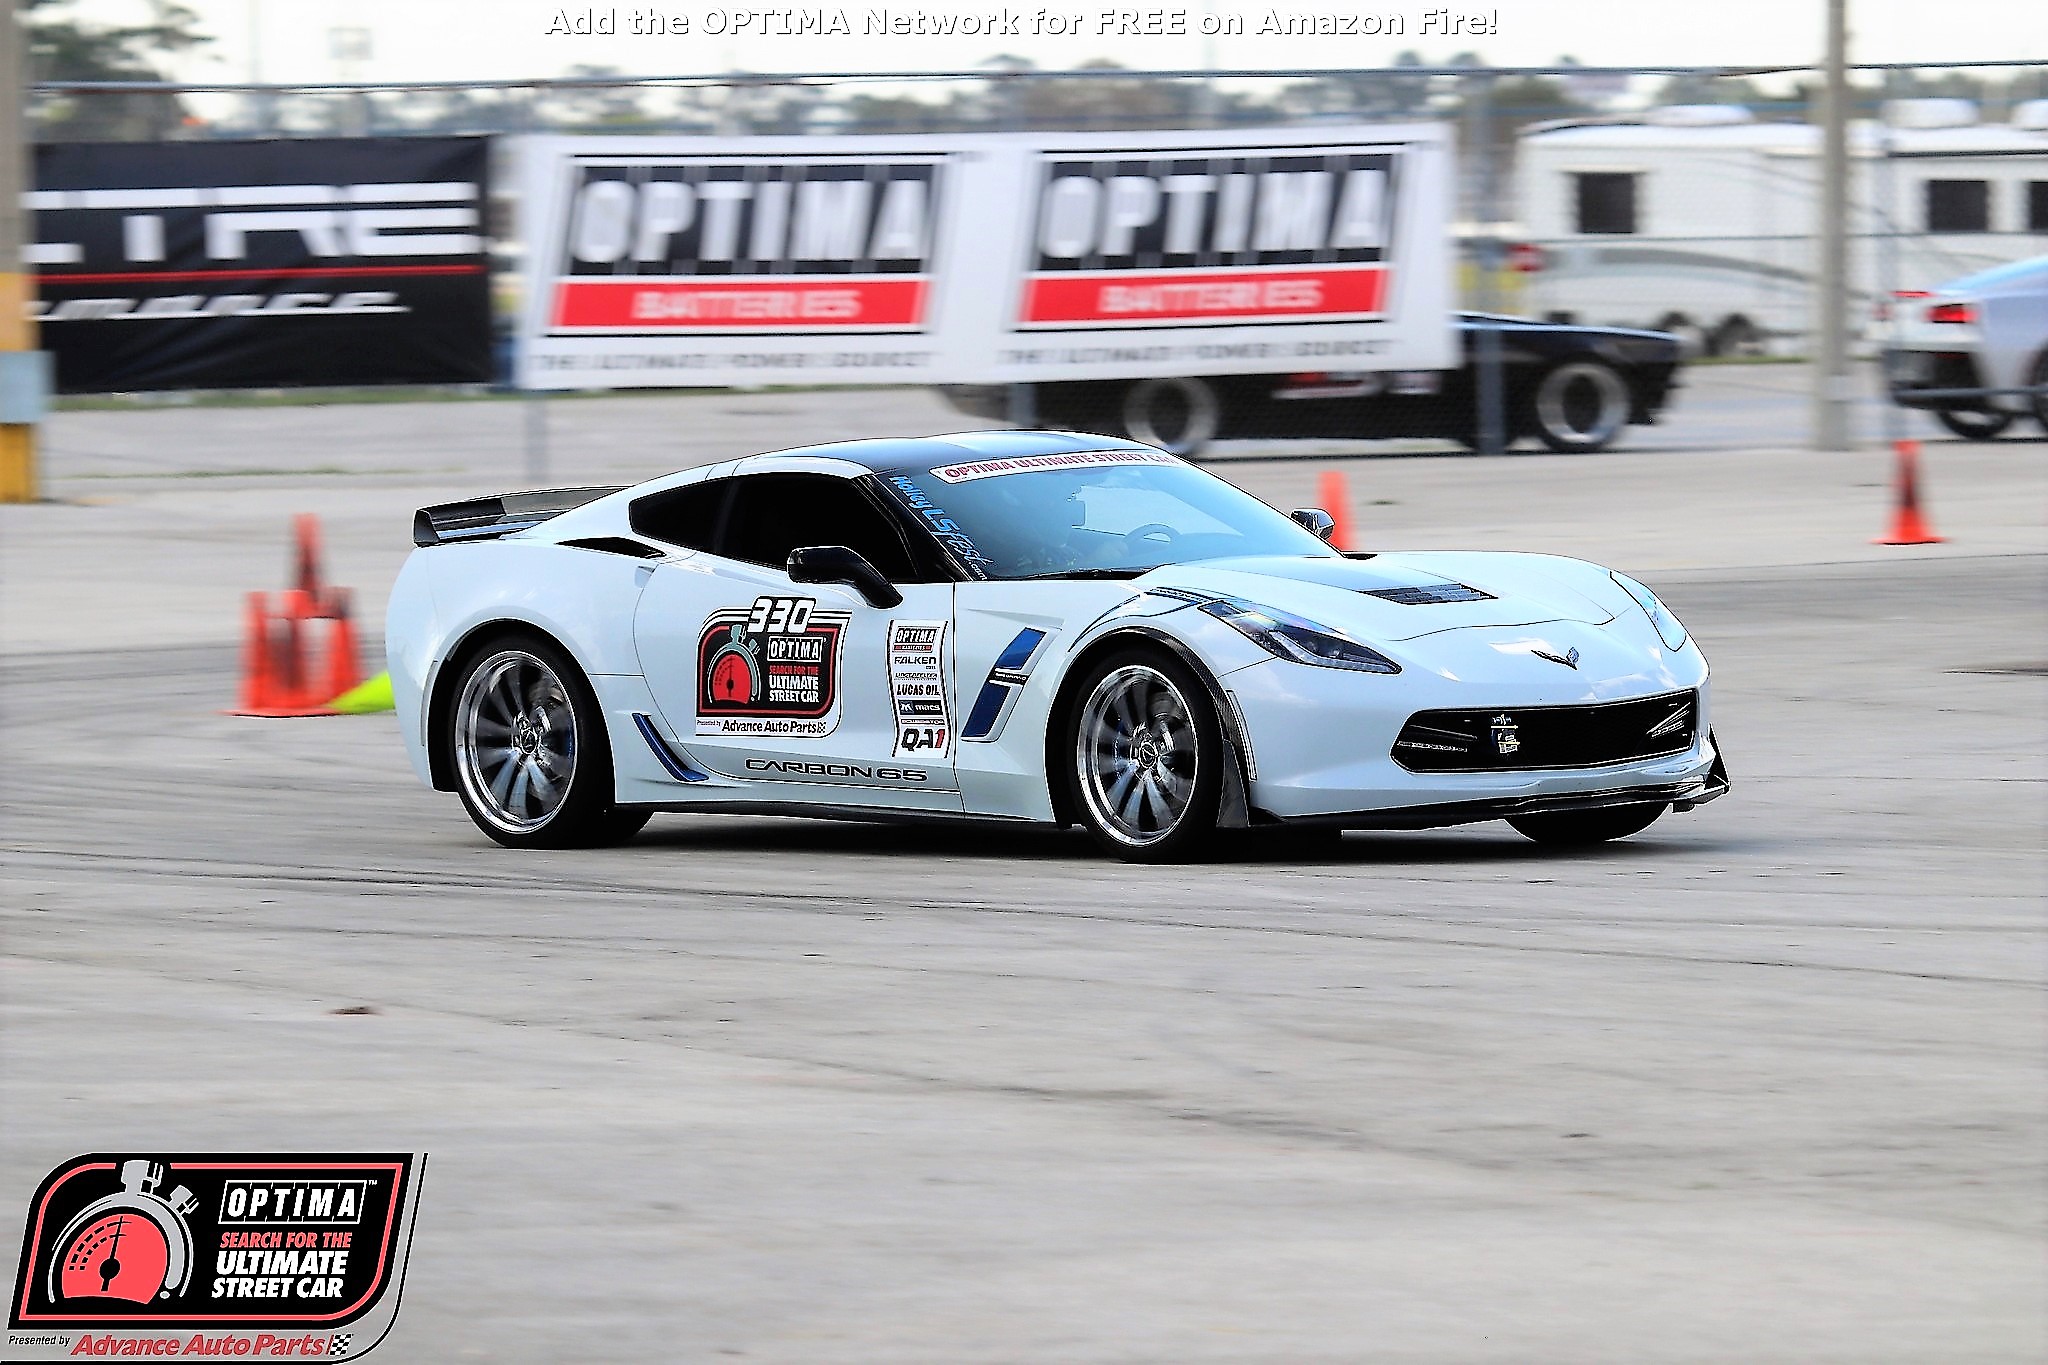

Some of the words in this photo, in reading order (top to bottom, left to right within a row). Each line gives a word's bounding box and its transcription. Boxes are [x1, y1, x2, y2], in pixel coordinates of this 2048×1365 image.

[567, 178, 929, 264] OPTIMA
[1037, 169, 1390, 259] OPTIMA
[944, 461, 1015, 478] OPTIMA
[1014, 454, 1094, 468] ULTIMATE
[1092, 453, 1147, 462] STREET
[889, 475, 933, 508] Holley
[747, 598, 816, 633] 330
[896, 629, 935, 643] OPTIMA
[770, 638, 819, 660] OPTIMA
[895, 656, 937, 665] FALKEN
[769, 675, 819, 690] ULTIMATE
[897, 684, 924, 696] LUCAS
[925, 684, 941, 696] OIL
[769, 689, 800, 702] STREET
[801, 690, 819, 703] CAR
[721, 719, 763, 732] Advance
[764, 720, 789, 733] Auto
[789, 721, 817, 734] Parts
[901, 728, 946, 752] QA1
[745, 758, 872, 778] CARBON
[876, 767, 928, 782] 65
